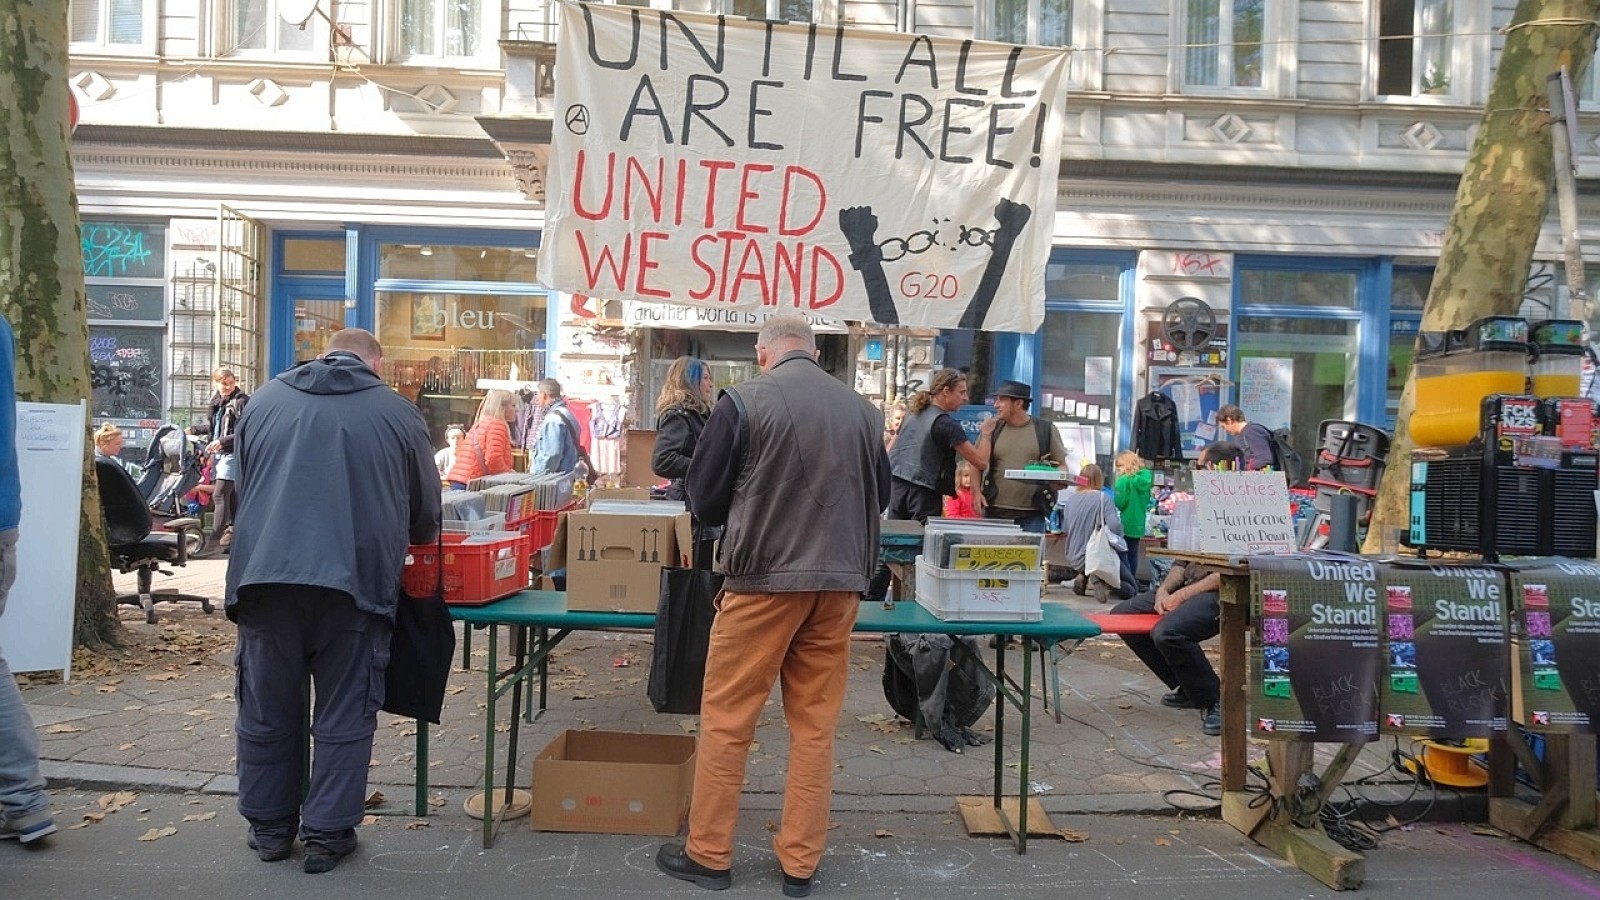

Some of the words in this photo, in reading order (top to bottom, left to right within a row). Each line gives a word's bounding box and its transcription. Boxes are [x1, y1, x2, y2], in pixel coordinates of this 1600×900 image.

[580, 3, 867, 81] UNTIL
[895, 35, 1037, 98] ALL
[619, 74, 784, 150] ARE
[854, 90, 1047, 169] FREE!
[572, 149, 826, 236] UNITED
[575, 230, 671, 298] WE
[689, 231, 844, 310] STAND
[900, 272, 958, 299] G20
[432, 297, 495, 330] bleu
[634, 304, 689, 321] another
[1503, 404, 1536, 417] FCK
[1503, 416, 1537, 429] NZS
[1210, 479, 1276, 496] Slushies
[1213, 509, 1287, 526] Hurricane
[1222, 528, 1256, 543] Touch
[1258, 529, 1290, 542] Down
[1307, 560, 1376, 581] United
[1344, 582, 1377, 603] We
[1466, 579, 1500, 600] We
[1311, 603, 1377, 625] Stand!
[1435, 599, 1501, 621] Stand!
[1312, 673, 1360, 702] BLACK
